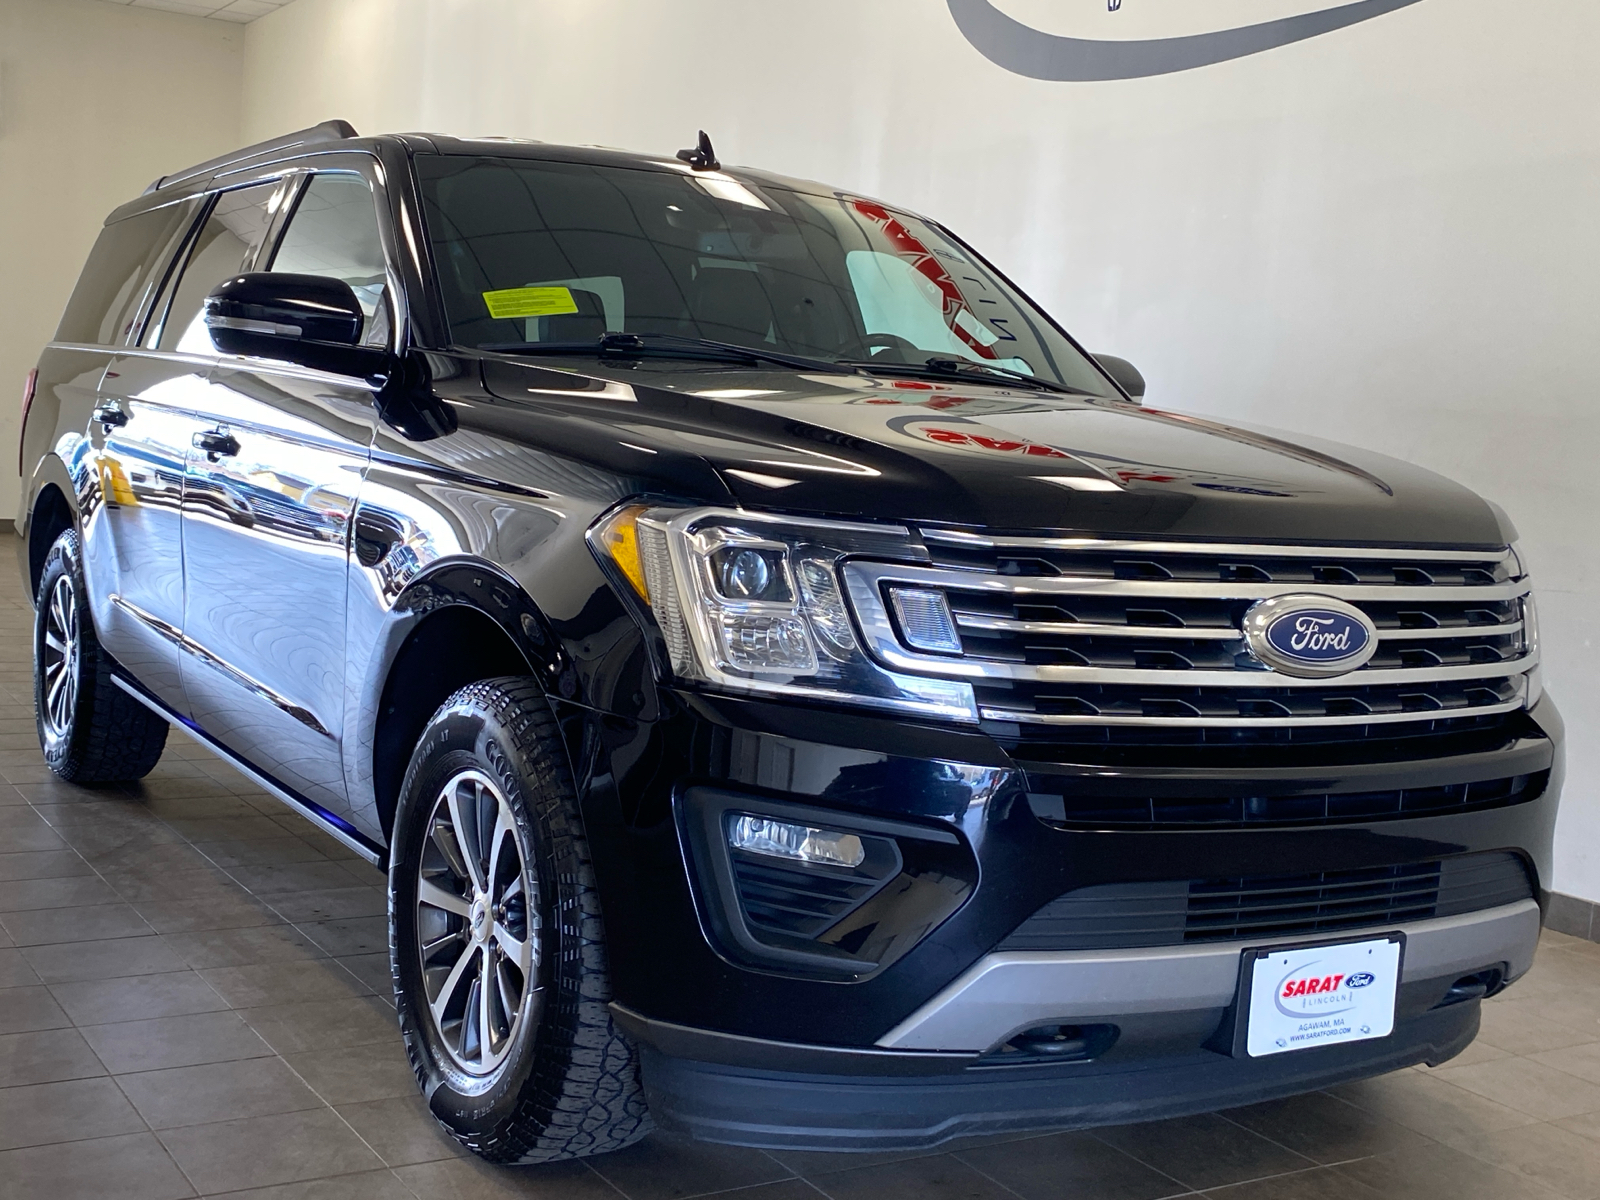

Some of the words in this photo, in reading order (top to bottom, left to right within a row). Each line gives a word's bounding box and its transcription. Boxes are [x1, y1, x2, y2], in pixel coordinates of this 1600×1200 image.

[1290, 616, 1351, 651] Ford
[1282, 974, 1345, 998] SARAT
[1349, 973, 1371, 987] Ford
[1308, 994, 1347, 1006] LINCOLN
[1298, 1020, 1332, 1032] AGAWAM,
[1333, 1018, 1345, 1027] MA
[1289, 1027, 1352, 1042] WWW.SARATFORD.COM
